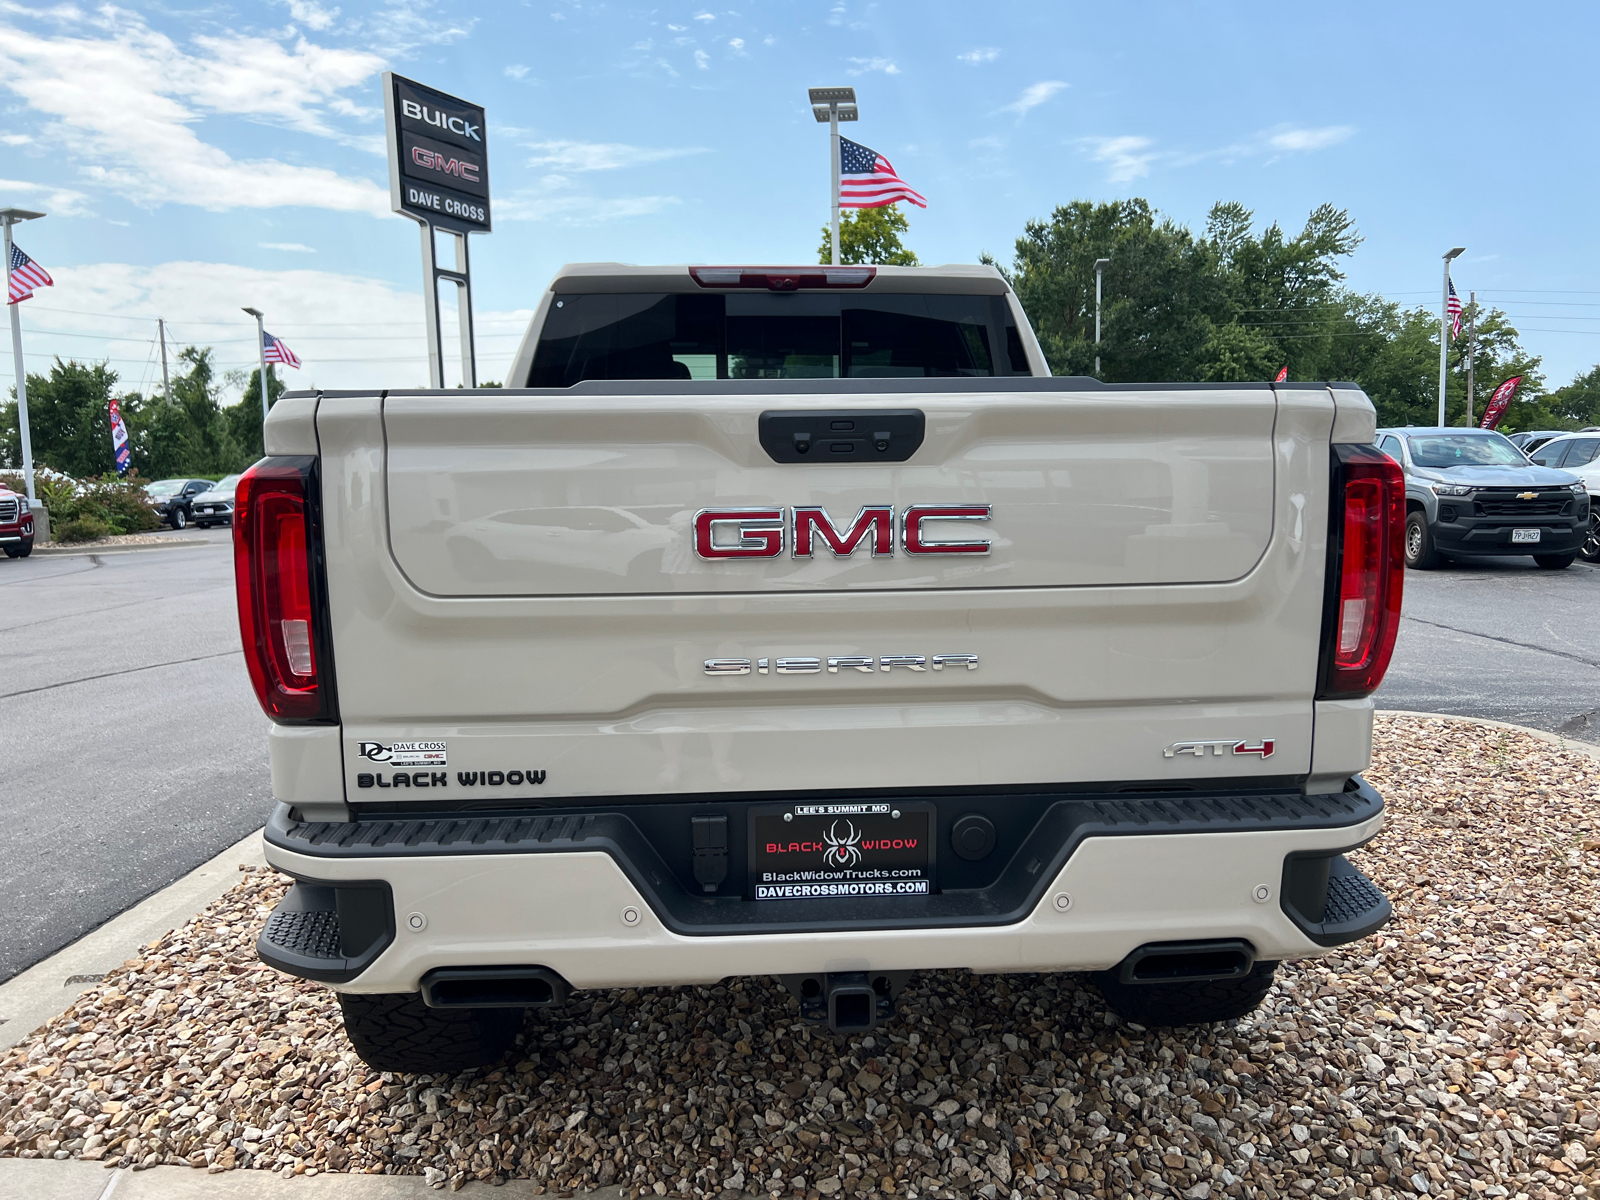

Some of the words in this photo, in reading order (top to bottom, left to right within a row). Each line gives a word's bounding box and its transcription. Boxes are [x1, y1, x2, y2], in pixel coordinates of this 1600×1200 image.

[402, 99, 481, 142] BUICK
[412, 146, 480, 182] GMC
[409, 188, 441, 210] DAVE
[445, 198, 485, 222] CROSS
[692, 503, 993, 561] GMC
[703, 653, 980, 676] SIERRA
[418, 742, 446, 750] CROSS
[1163, 738, 1276, 760] AT4
[357, 772, 448, 788] BLACK
[457, 769, 546, 786] WIDOW
[797, 806, 825, 814] LEE'S
[827, 805, 868, 813] SUMMIT
[766, 841, 823, 853] BLACK
[861, 838, 918, 850] WIDOW
[762, 868, 921, 882] BlackWidowTrucks.com
[758, 881, 927, 898] DAVECROSSMOTORS.COM
